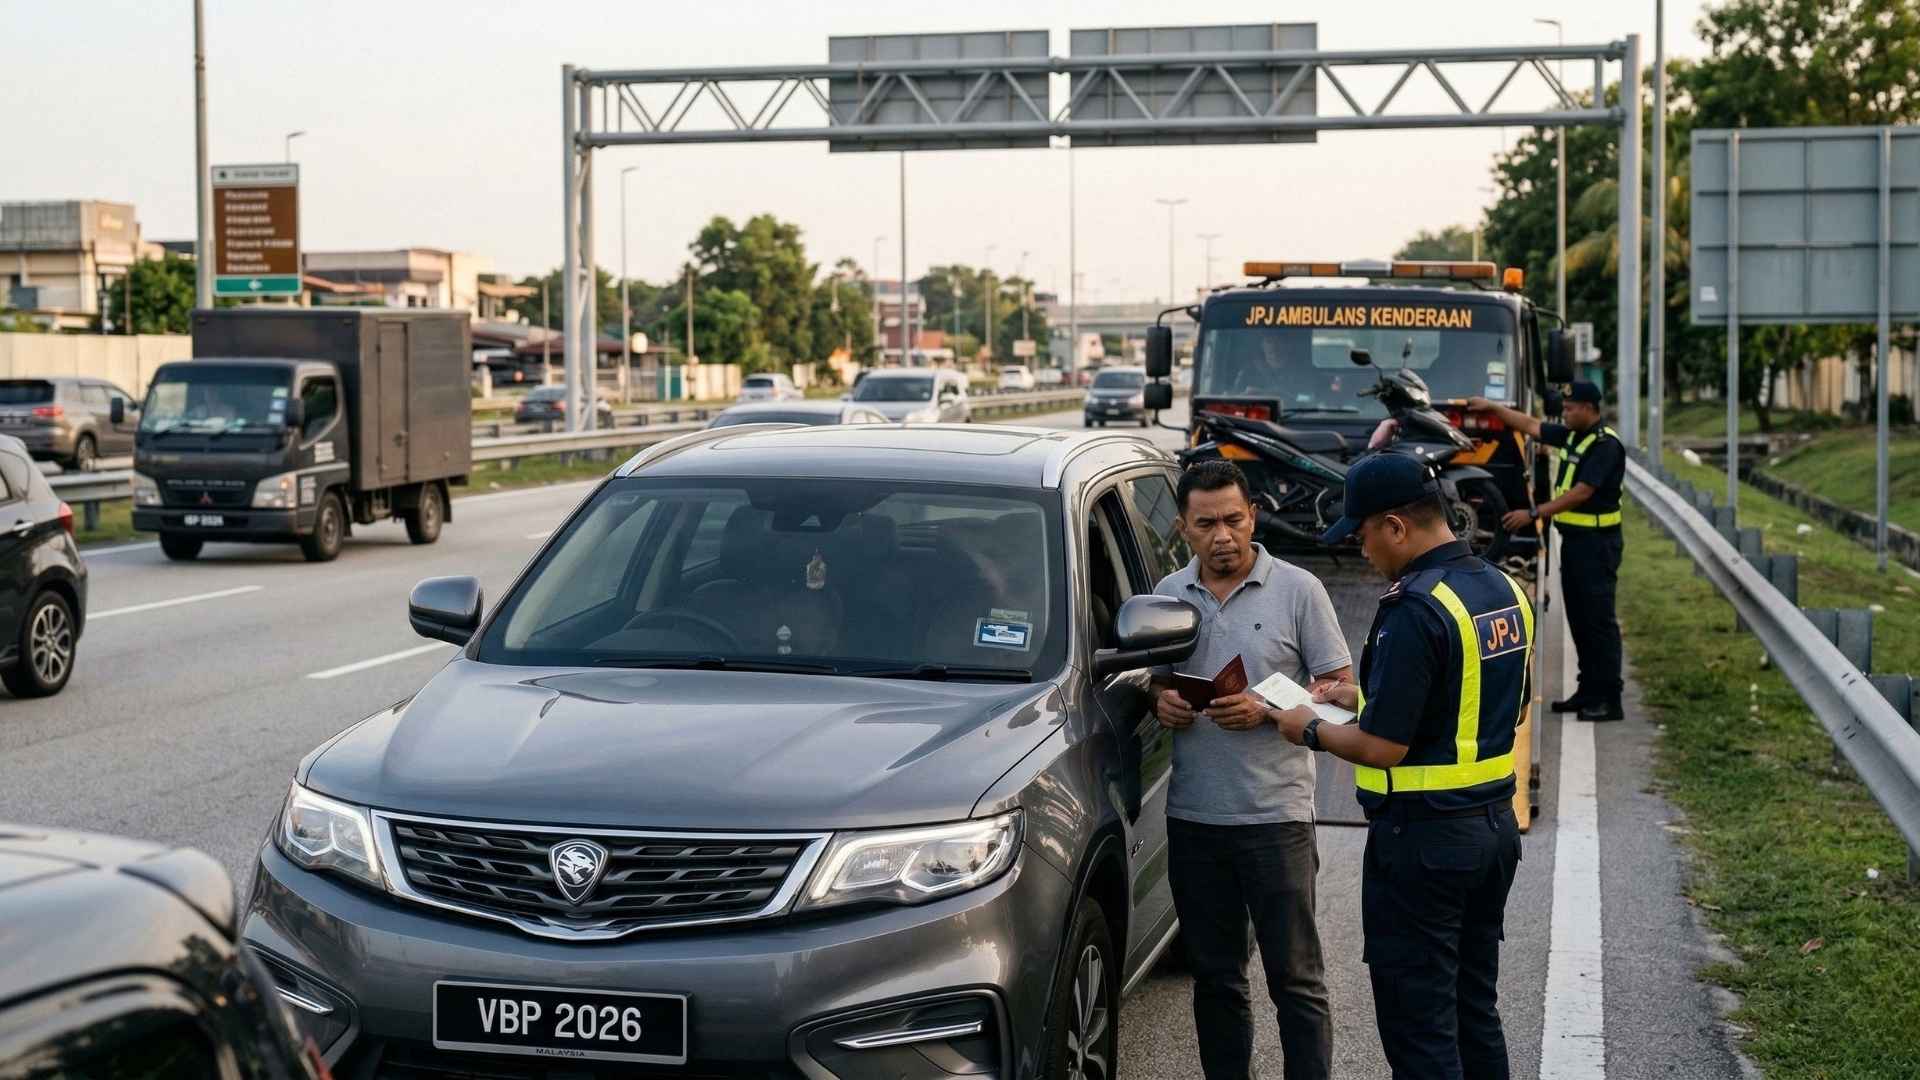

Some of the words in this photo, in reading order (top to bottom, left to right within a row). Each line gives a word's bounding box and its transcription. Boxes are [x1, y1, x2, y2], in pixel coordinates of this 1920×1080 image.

[1246, 305, 1274, 325] JPJ
[1276, 306, 1367, 326] AMBULANS
[1370, 307, 1472, 328] KENDERAAN
[1487, 614, 1520, 650] JPJ
[477, 997, 542, 1035] VBP
[554, 1003, 642, 1042] 2026
[536, 1048, 585, 1057] MALAYSIA
